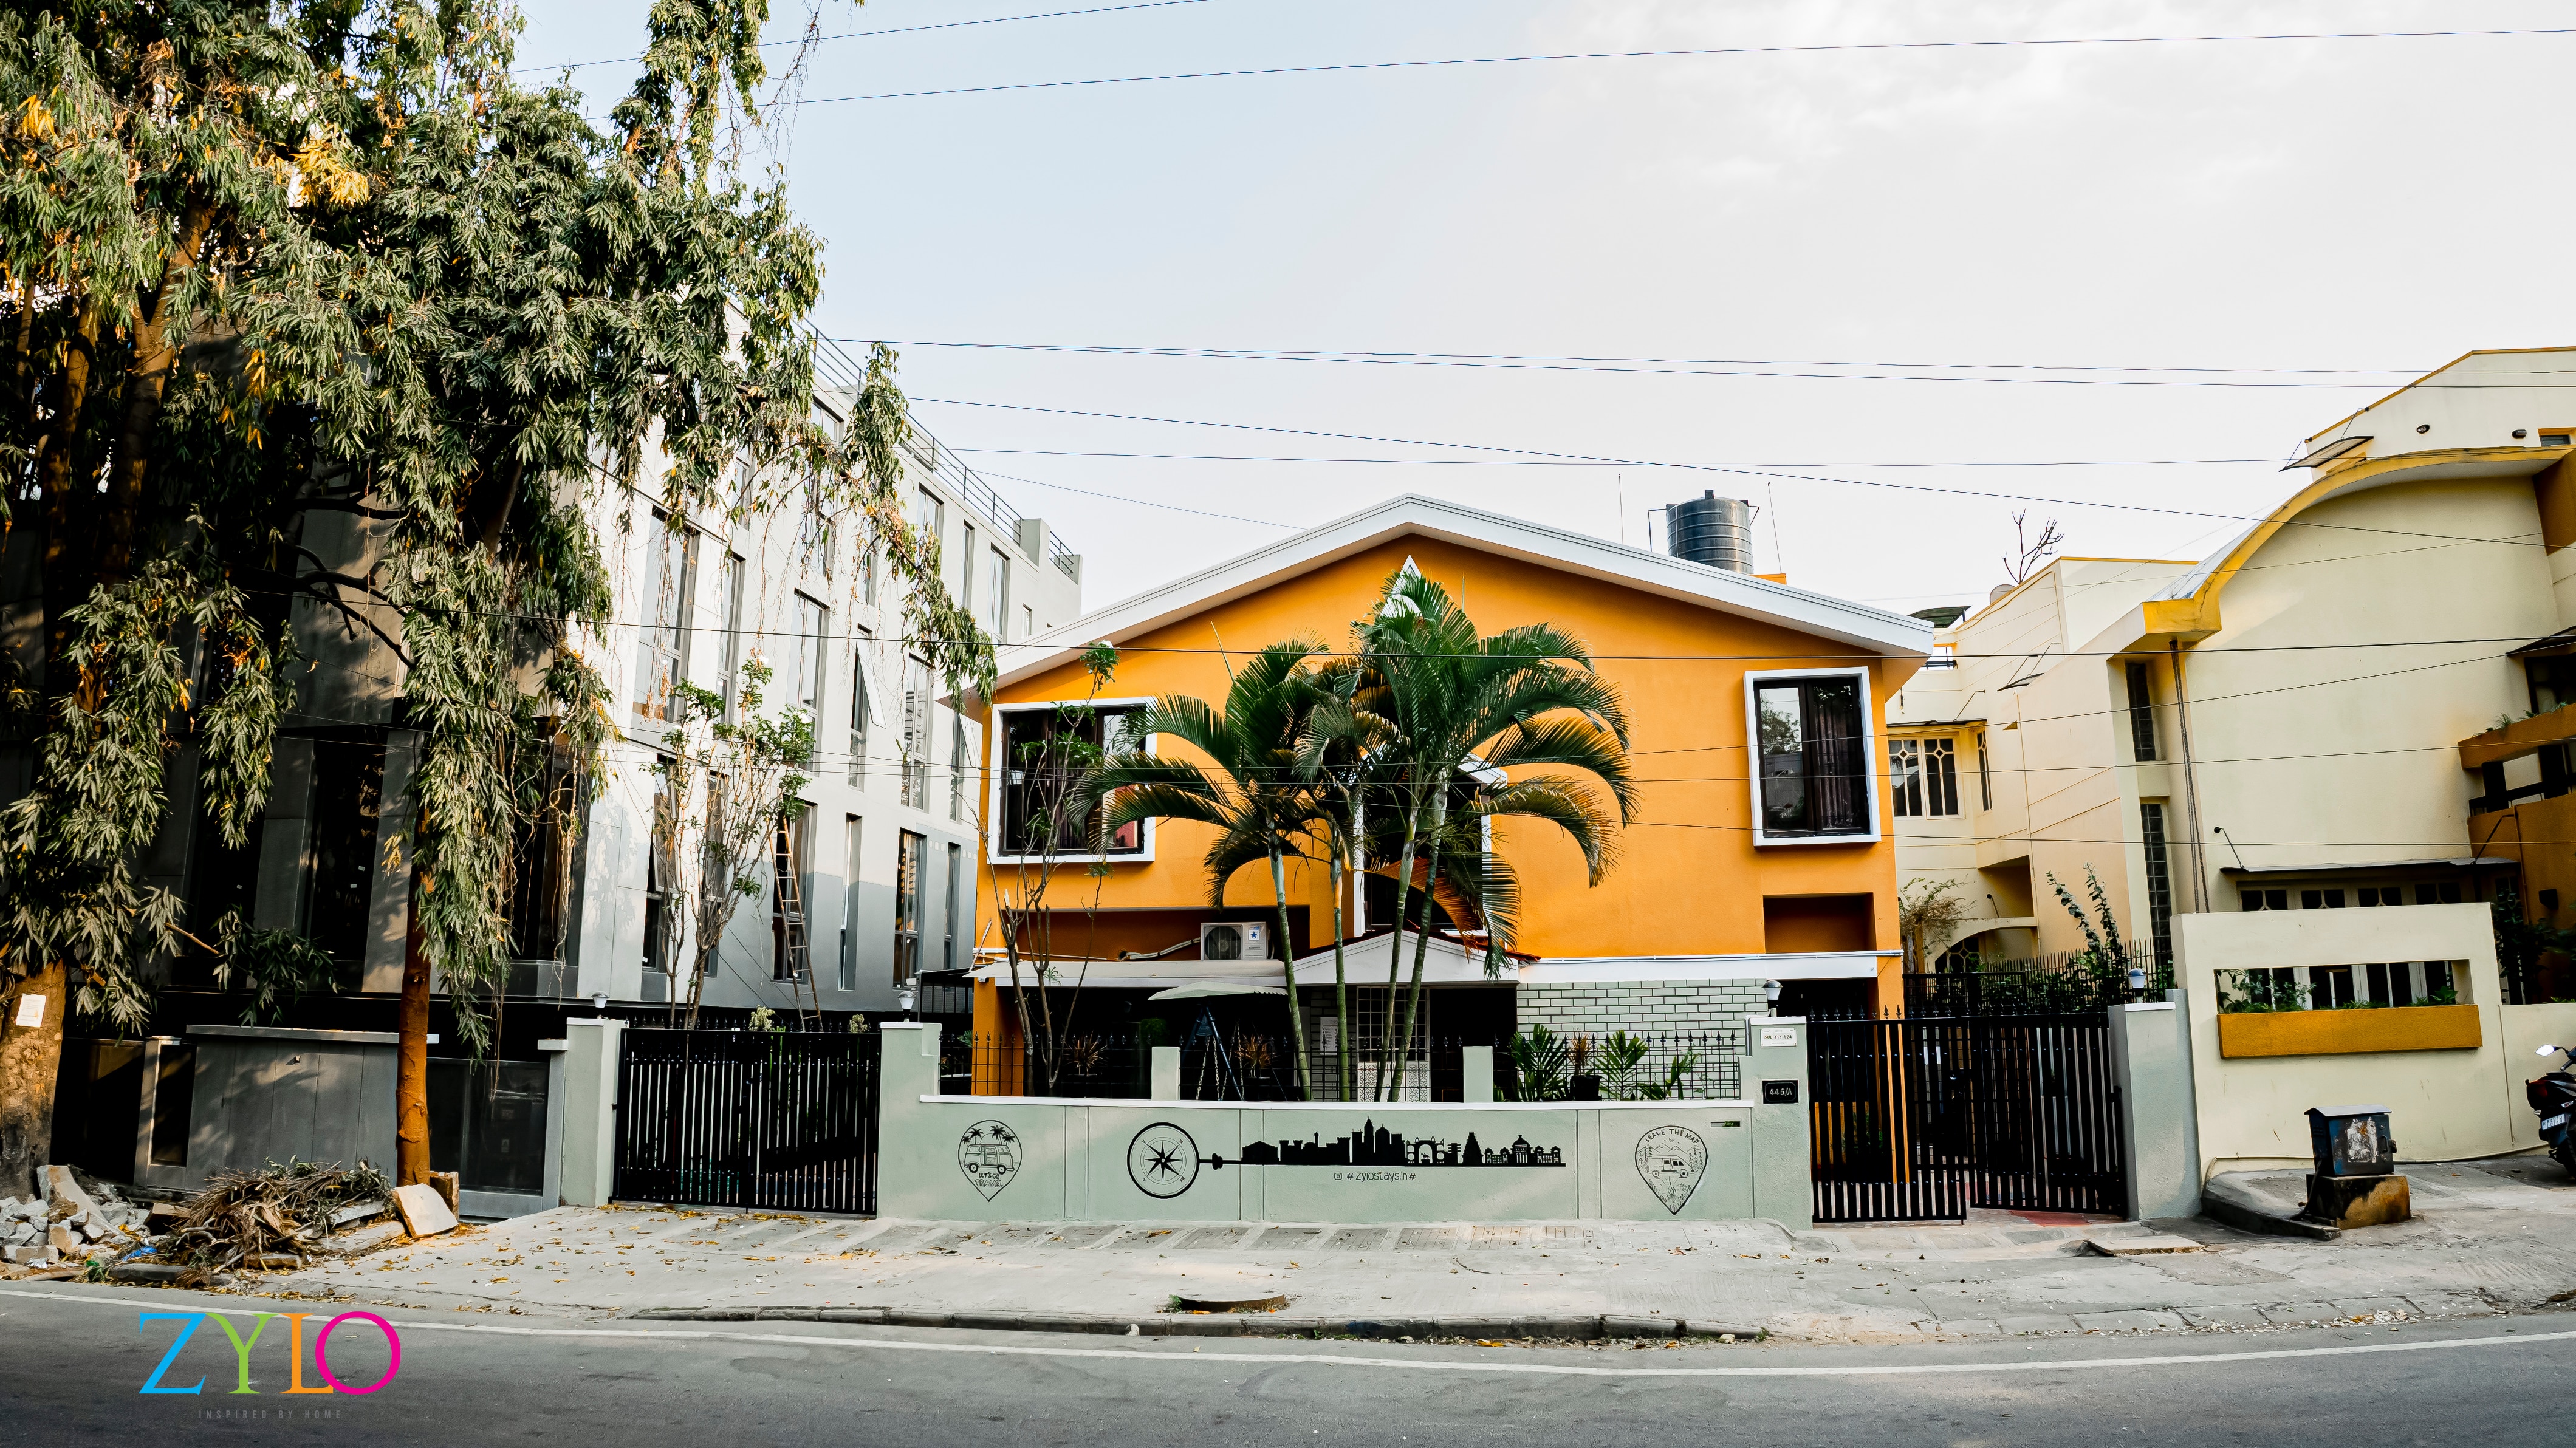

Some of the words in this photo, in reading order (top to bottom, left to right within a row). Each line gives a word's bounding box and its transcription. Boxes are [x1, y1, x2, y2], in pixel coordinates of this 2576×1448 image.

[1645, 1129, 1666, 1143] LEAVE
[1685, 1132, 1699, 1144] MAP
[975, 1179, 1004, 1188] TRAVEL
